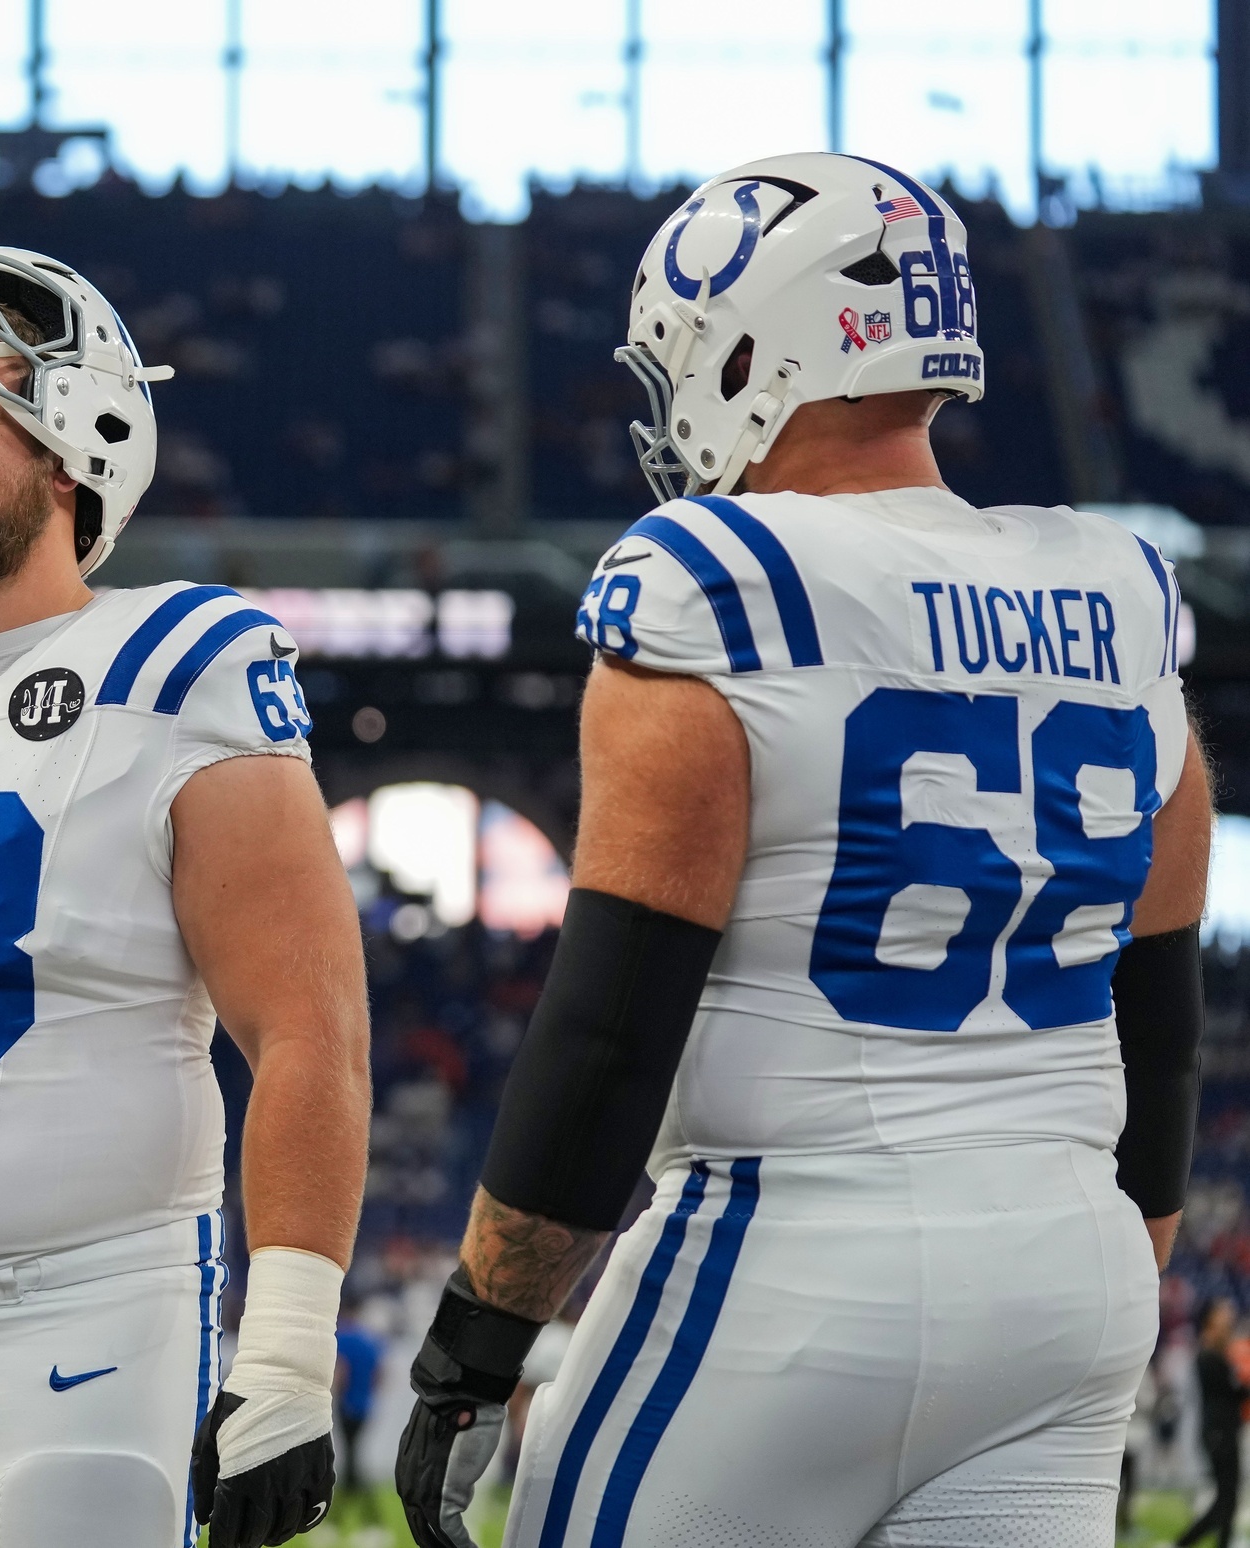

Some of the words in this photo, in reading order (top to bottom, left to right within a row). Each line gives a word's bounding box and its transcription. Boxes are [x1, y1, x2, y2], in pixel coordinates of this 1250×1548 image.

[867, 323, 890, 340] NFL
[899, 250, 975, 339] 68
[922, 353, 981, 381] COLTS
[911, 582, 1121, 685] TUCKER
[809, 687, 1162, 1032] 68
